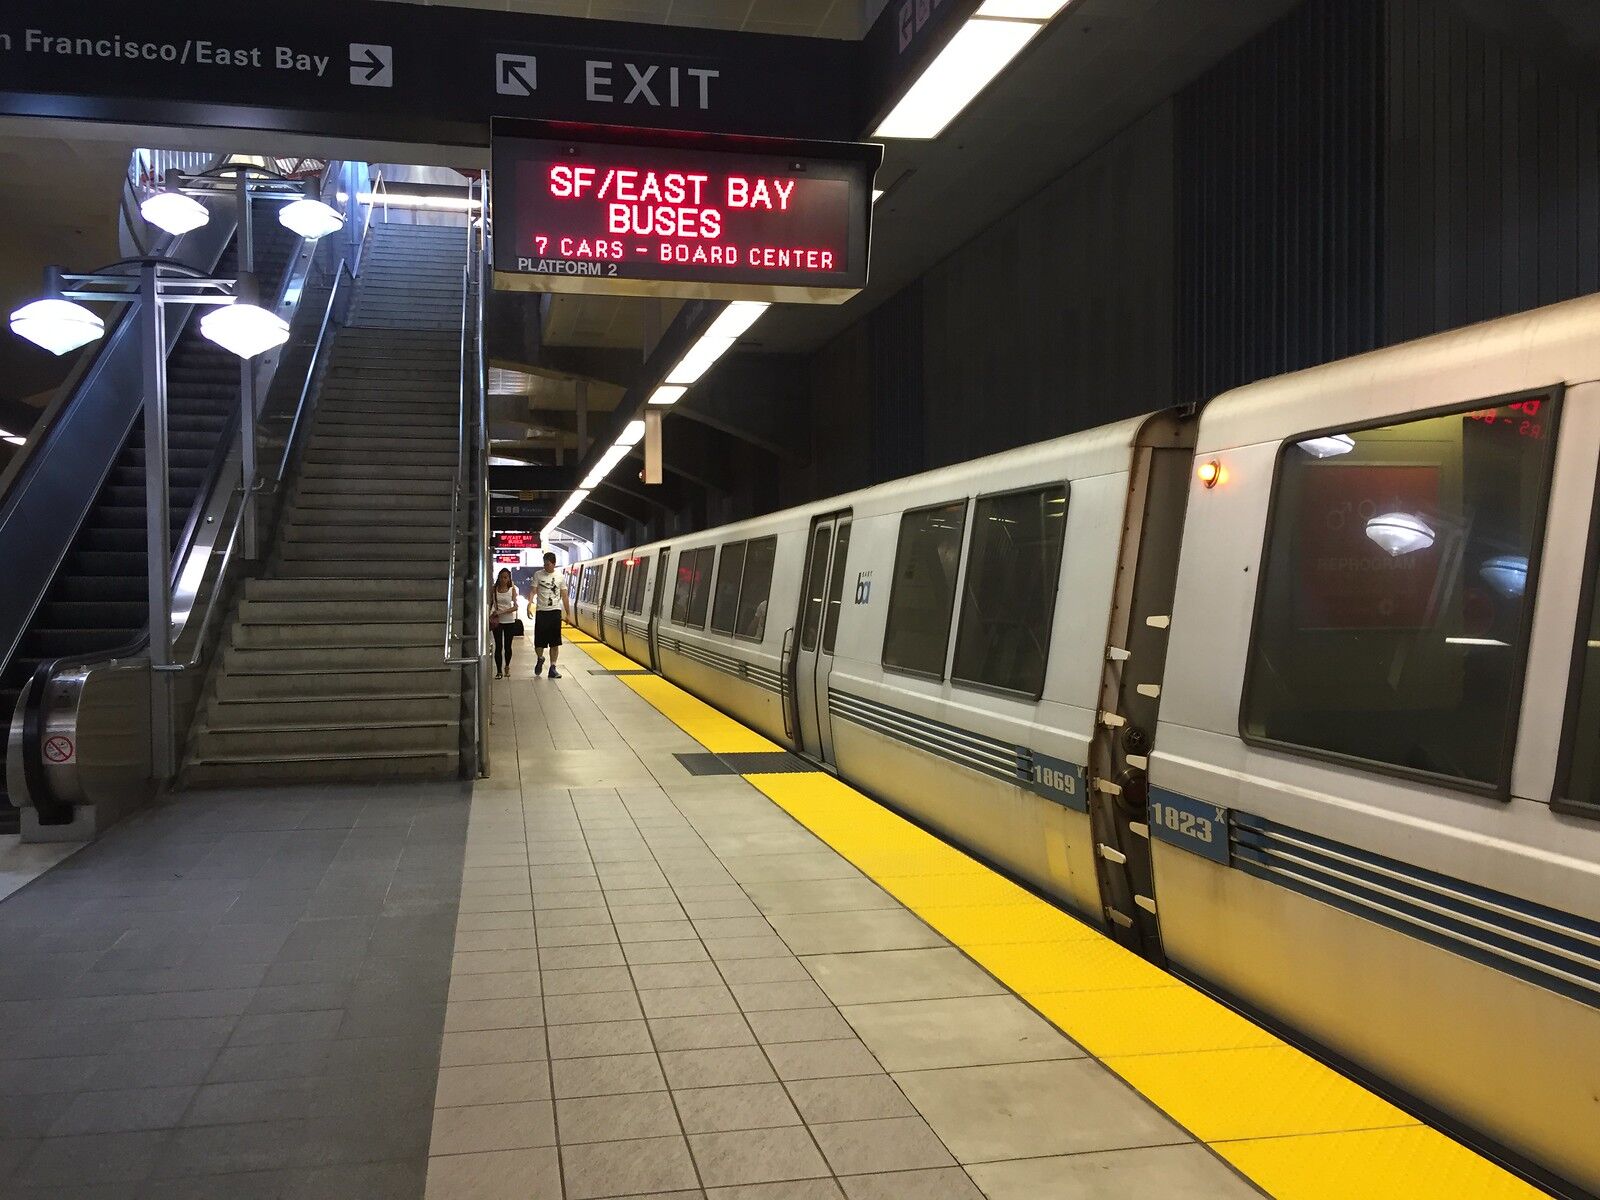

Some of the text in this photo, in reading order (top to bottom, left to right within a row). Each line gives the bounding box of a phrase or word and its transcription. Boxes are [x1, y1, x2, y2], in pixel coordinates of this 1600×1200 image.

[25, 29, 261, 68] Francisco/East
[275, 46, 330, 77] Bay
[585, 60, 720, 110] EXIT
[550, 165, 795, 211] SF/EAST BAY
[608, 203, 721, 239] BUSES
[517, 257, 618, 277] PLATFORM 2
[535, 236, 548, 256] 7
[560, 238, 624, 260] CARS
[660, 242, 738, 266] BOARD
[749, 247, 834, 270] CENTER
[1034, 765, 1076, 795] 1869
[1151, 802, 1225, 844] 1823 X
